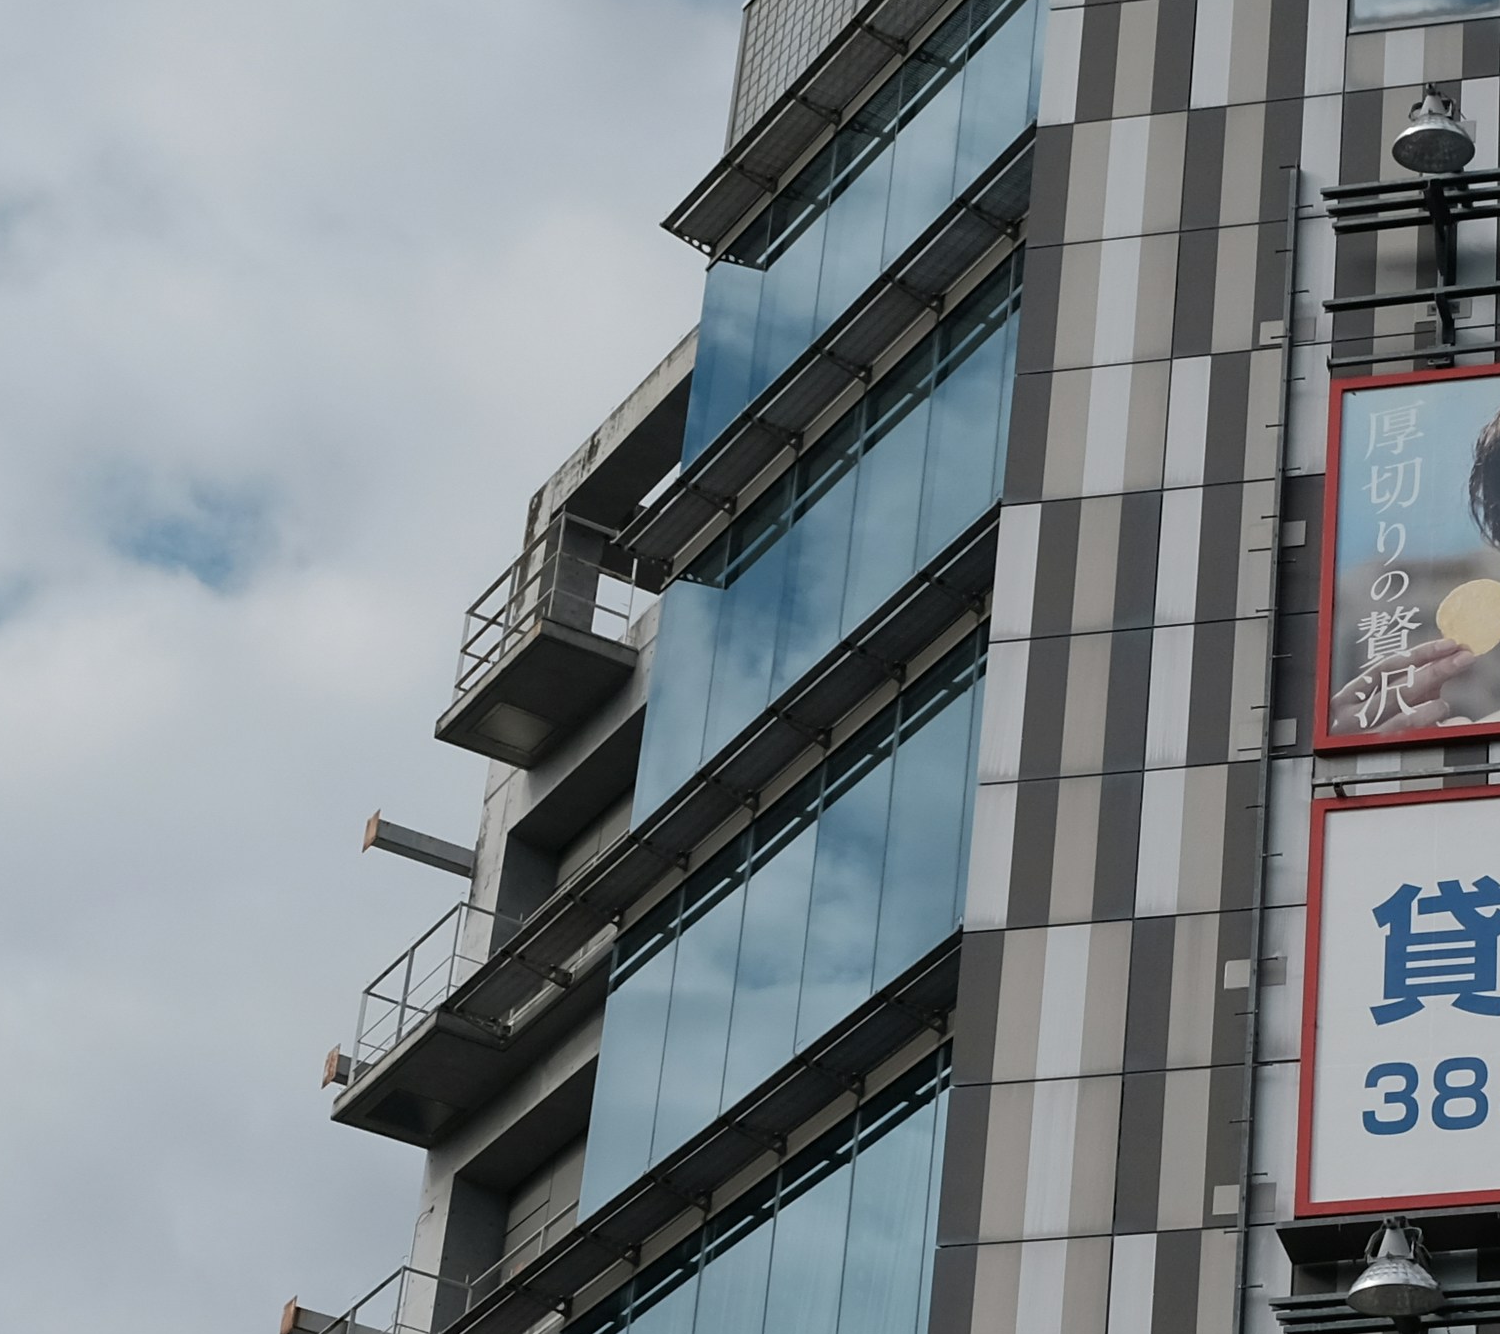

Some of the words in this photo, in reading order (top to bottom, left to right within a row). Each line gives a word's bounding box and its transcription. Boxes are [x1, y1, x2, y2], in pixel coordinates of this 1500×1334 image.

[1354, 399, 1426, 730] 厚切りの贅沢
